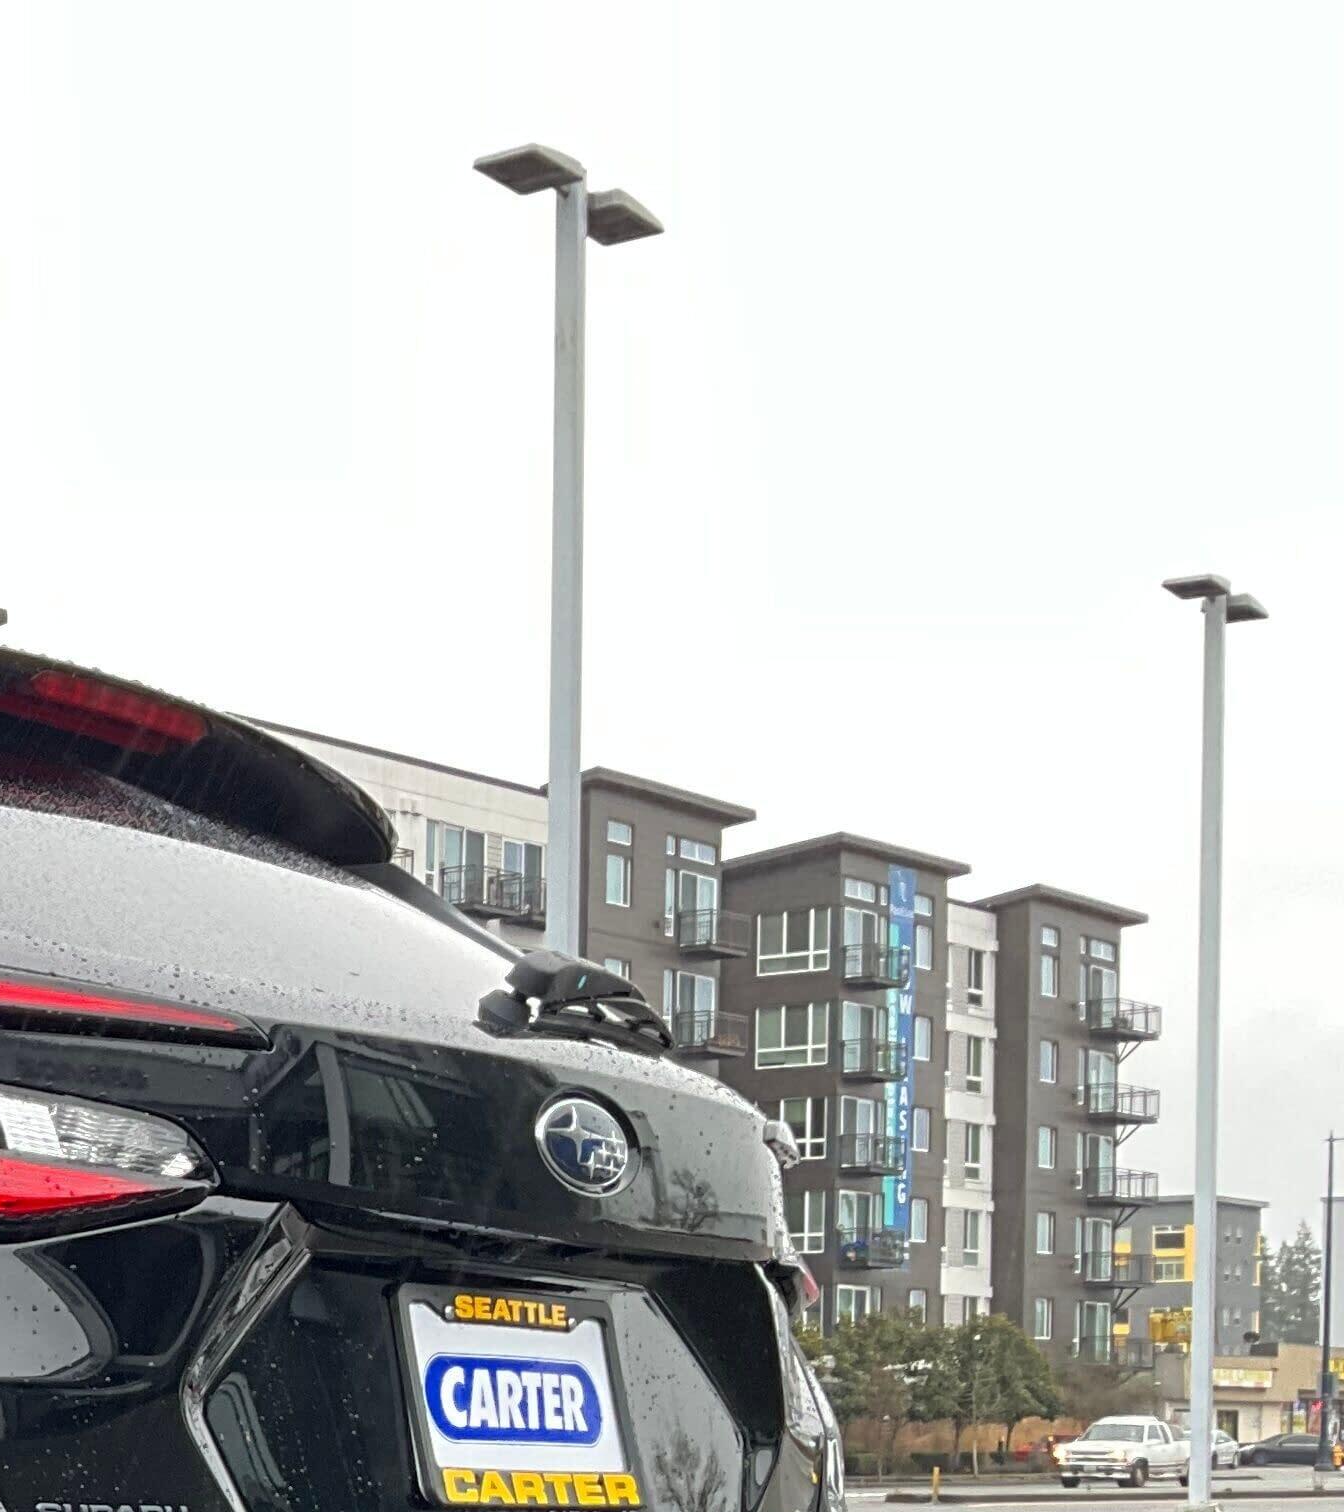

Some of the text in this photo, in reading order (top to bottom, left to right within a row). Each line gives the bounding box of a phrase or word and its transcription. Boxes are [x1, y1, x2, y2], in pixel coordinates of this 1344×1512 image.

[454, 1295, 567, 1326] SEATTLE
[439, 1365, 589, 1432] CARTER
[442, 1468, 640, 1505] CARTER
